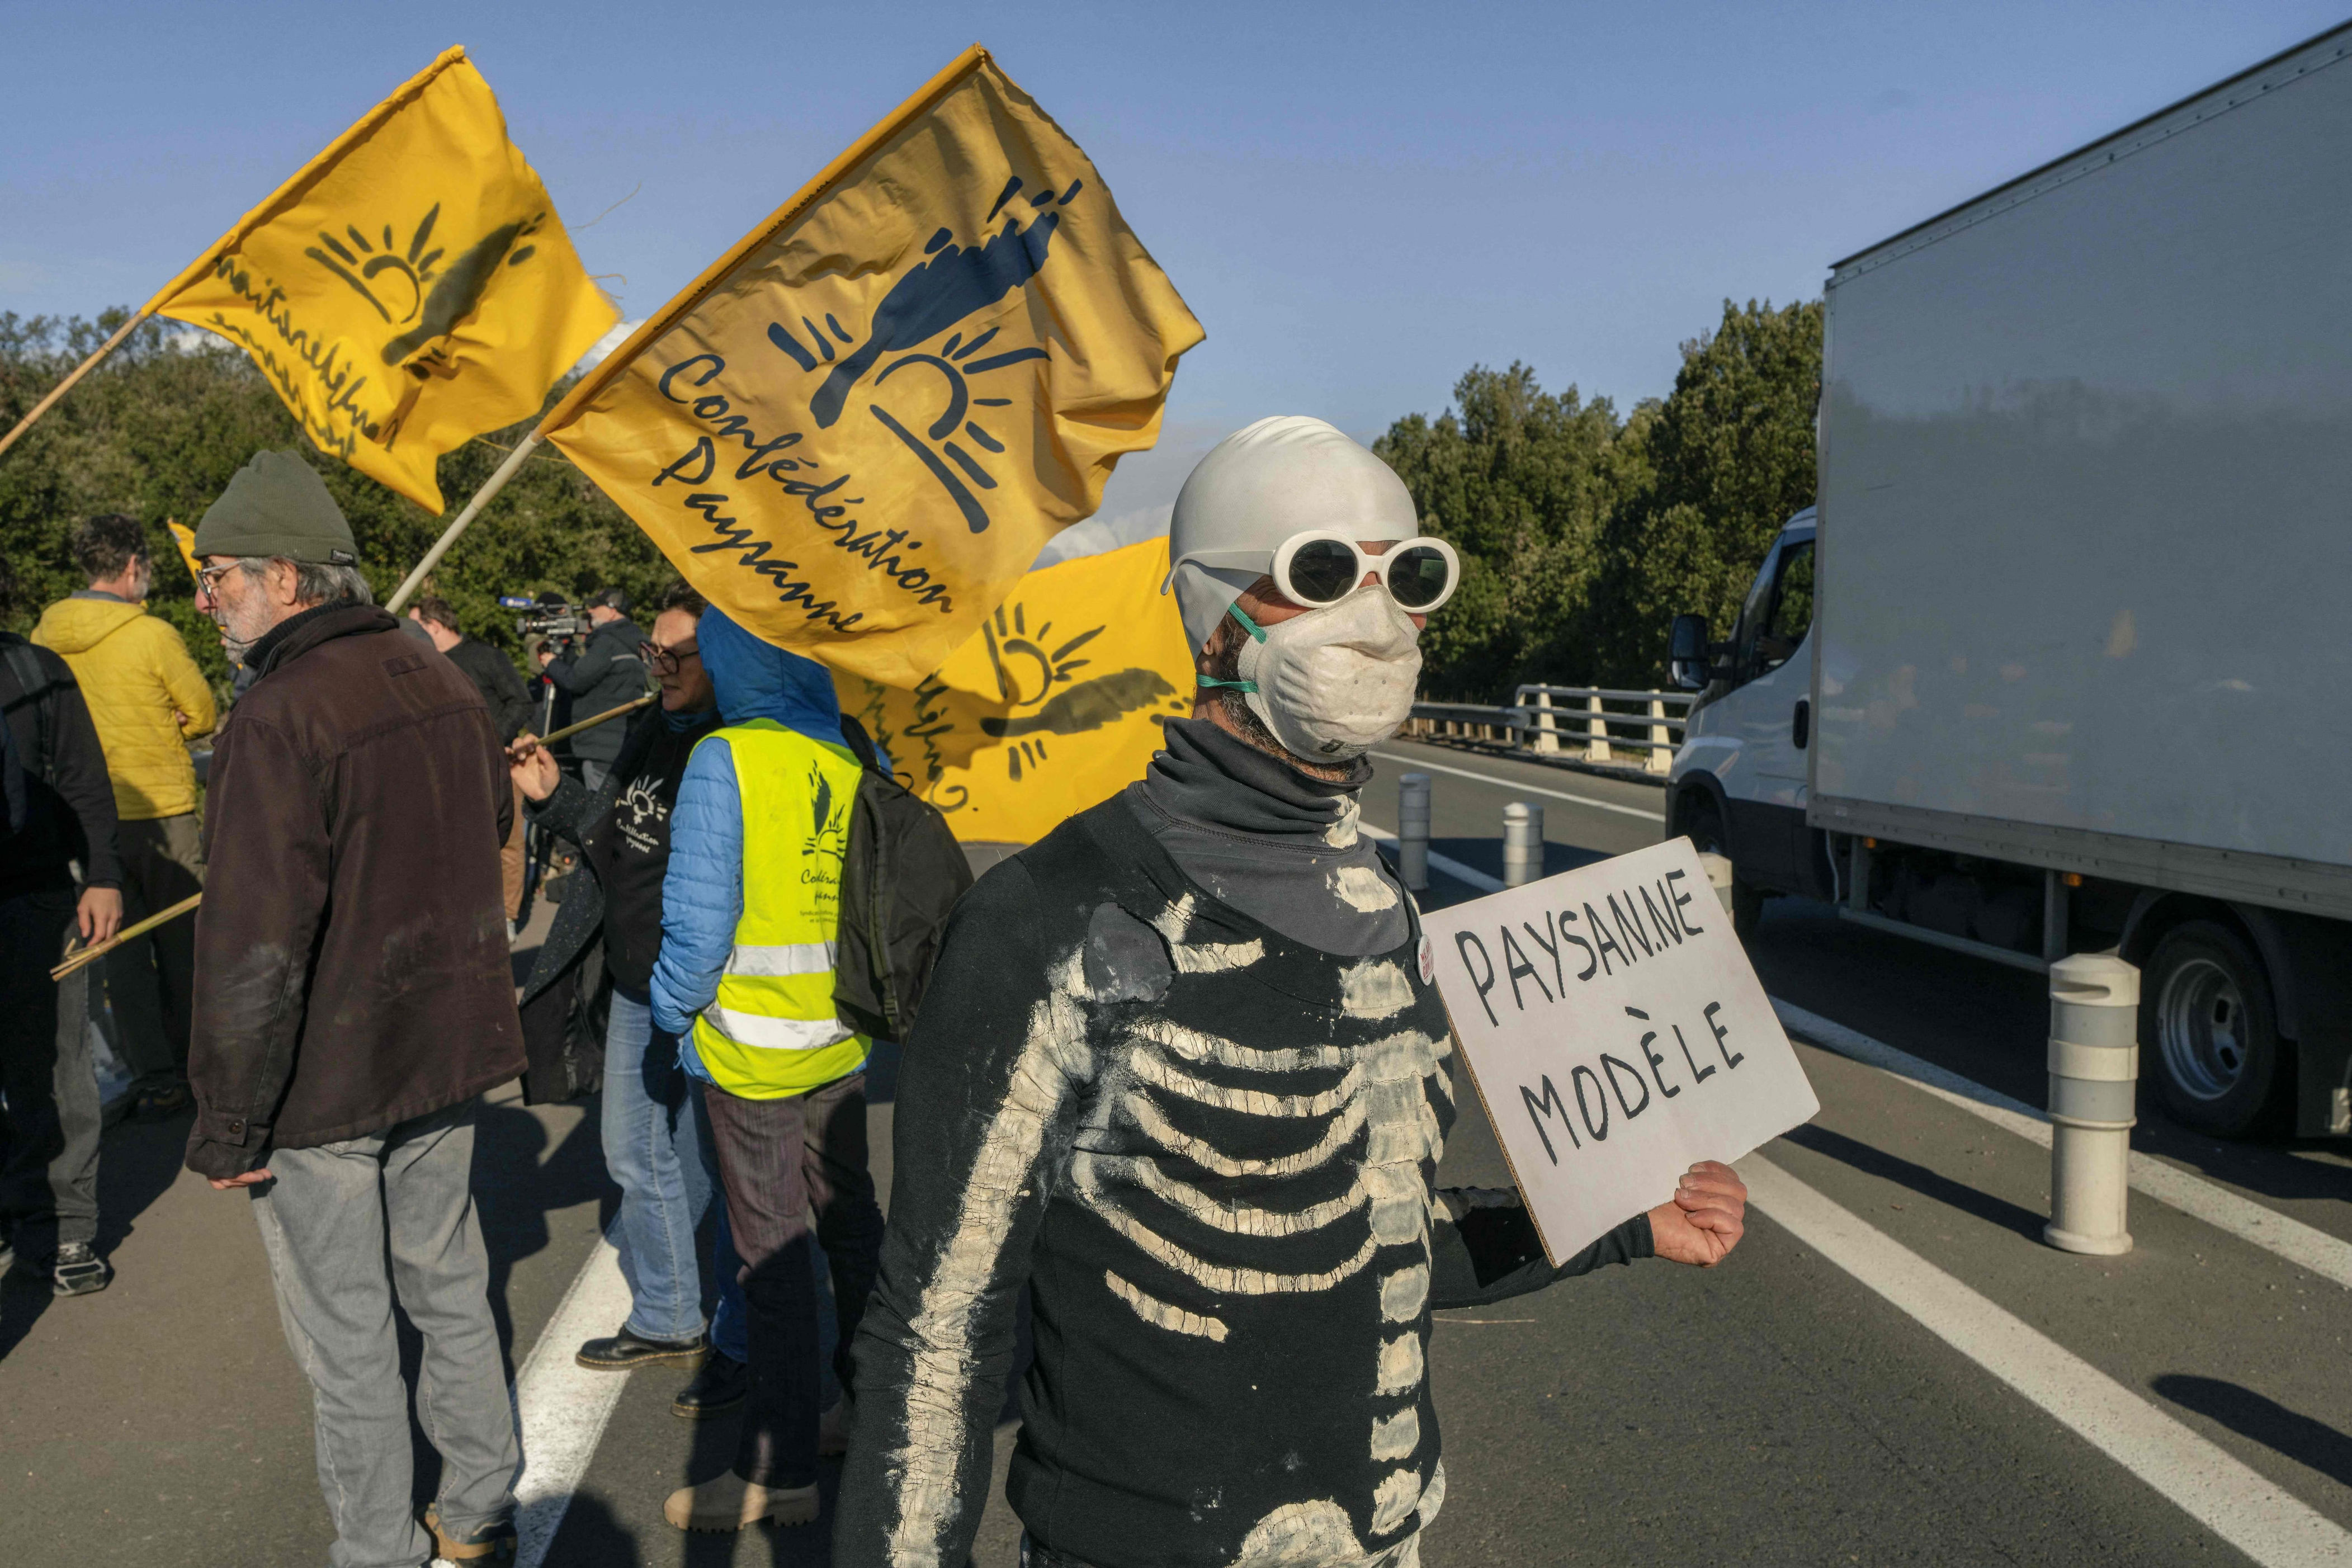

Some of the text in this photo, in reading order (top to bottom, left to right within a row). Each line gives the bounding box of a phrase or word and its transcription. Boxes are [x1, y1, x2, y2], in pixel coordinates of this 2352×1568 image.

[651, 436, 863, 632] Paysanne
[658, 353, 953, 613] Confédération
[1454, 868, 1704, 1027] PAYSAN.NE
[1519, 1001, 1744, 1166] MODÈLE
